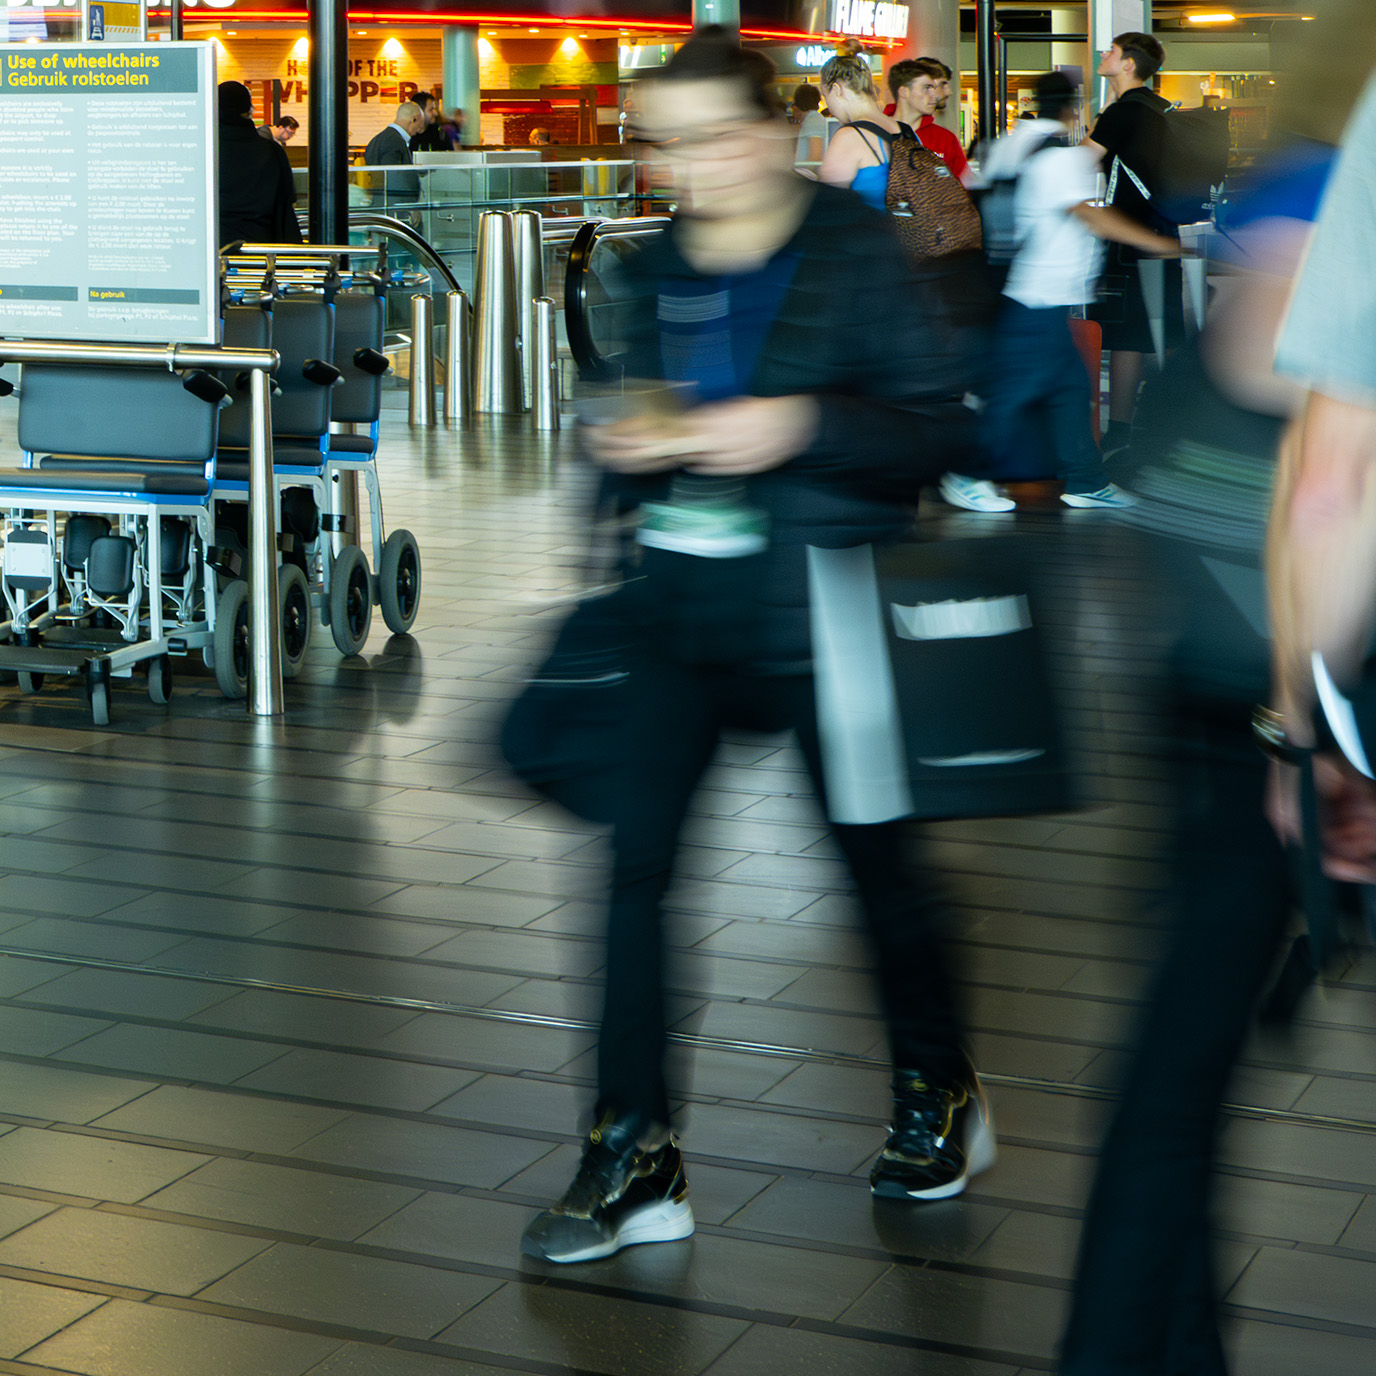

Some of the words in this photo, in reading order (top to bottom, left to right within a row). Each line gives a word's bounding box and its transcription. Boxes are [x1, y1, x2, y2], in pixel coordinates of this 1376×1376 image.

[8, 54, 36, 69] Use
[40, 53, 58, 68] of
[63, 53, 160, 68] wheelchairs
[367, 60, 398, 76] THE
[8, 71, 68, 86] Gebruik
[72, 70, 149, 86] rolstoelen
[100, 291, 125, 299] gebruik
